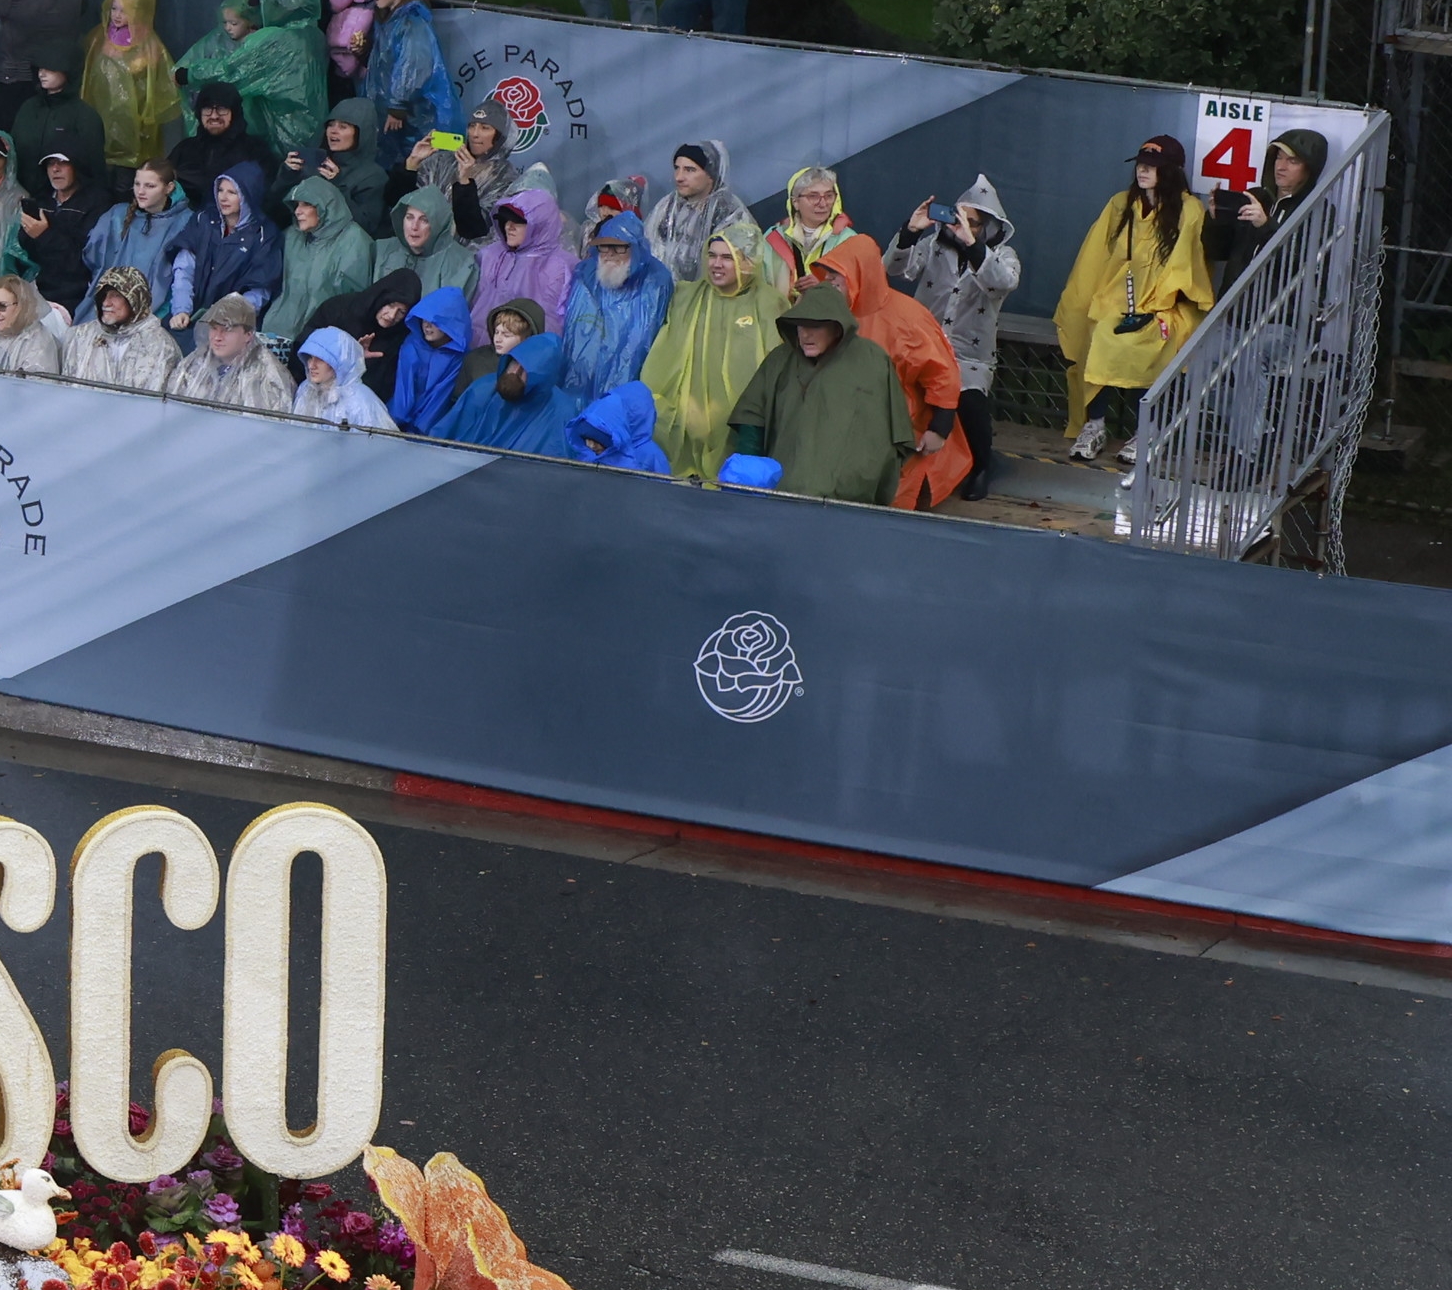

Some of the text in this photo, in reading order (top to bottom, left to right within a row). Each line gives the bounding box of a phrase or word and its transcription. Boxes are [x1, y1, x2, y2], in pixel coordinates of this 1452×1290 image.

[505, 45, 588, 139] PARADE
[1205, 100, 1263, 122] AISLE
[1201, 128, 1257, 193] 4
